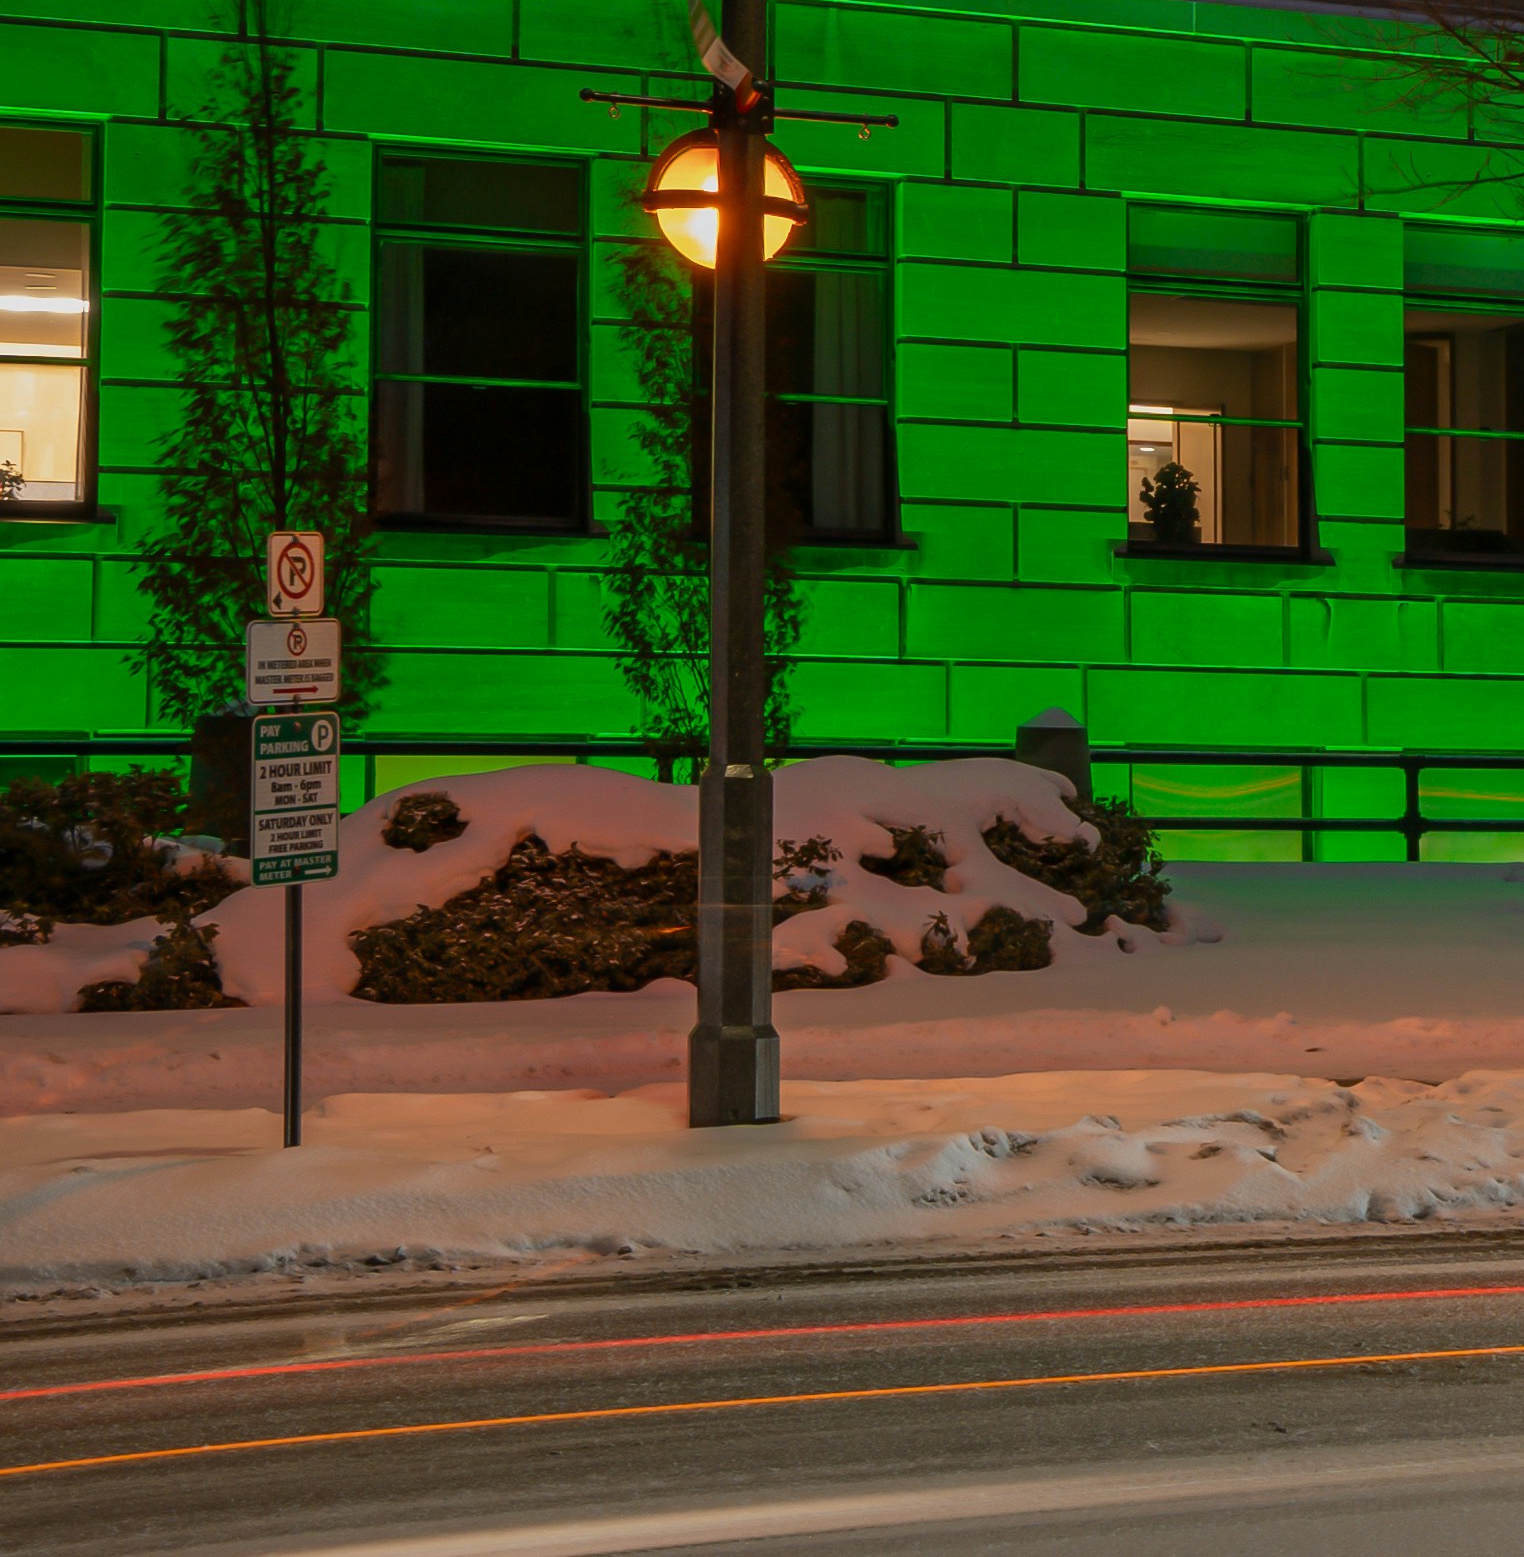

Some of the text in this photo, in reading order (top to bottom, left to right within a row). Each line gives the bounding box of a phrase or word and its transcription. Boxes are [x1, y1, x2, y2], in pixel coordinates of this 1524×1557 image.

[259, 724, 281, 738] PAY
[259, 740, 309, 755] PARKING
[259, 760, 332, 780] 2 HOUR LIMIT
[271, 781, 293, 793] 8am
[299, 779, 321, 794] 6pm
[274, 794, 296, 806] MON
[302, 792, 318, 804] SAT
[258, 812, 333, 831] SATURDAY ONLY
[270, 828, 322, 842] 2 HOUR LIMIT
[268, 840, 323, 854] FREE PARKING
[259, 854, 332, 871] PAY AT MASTER
[259, 869, 292, 881] METER
